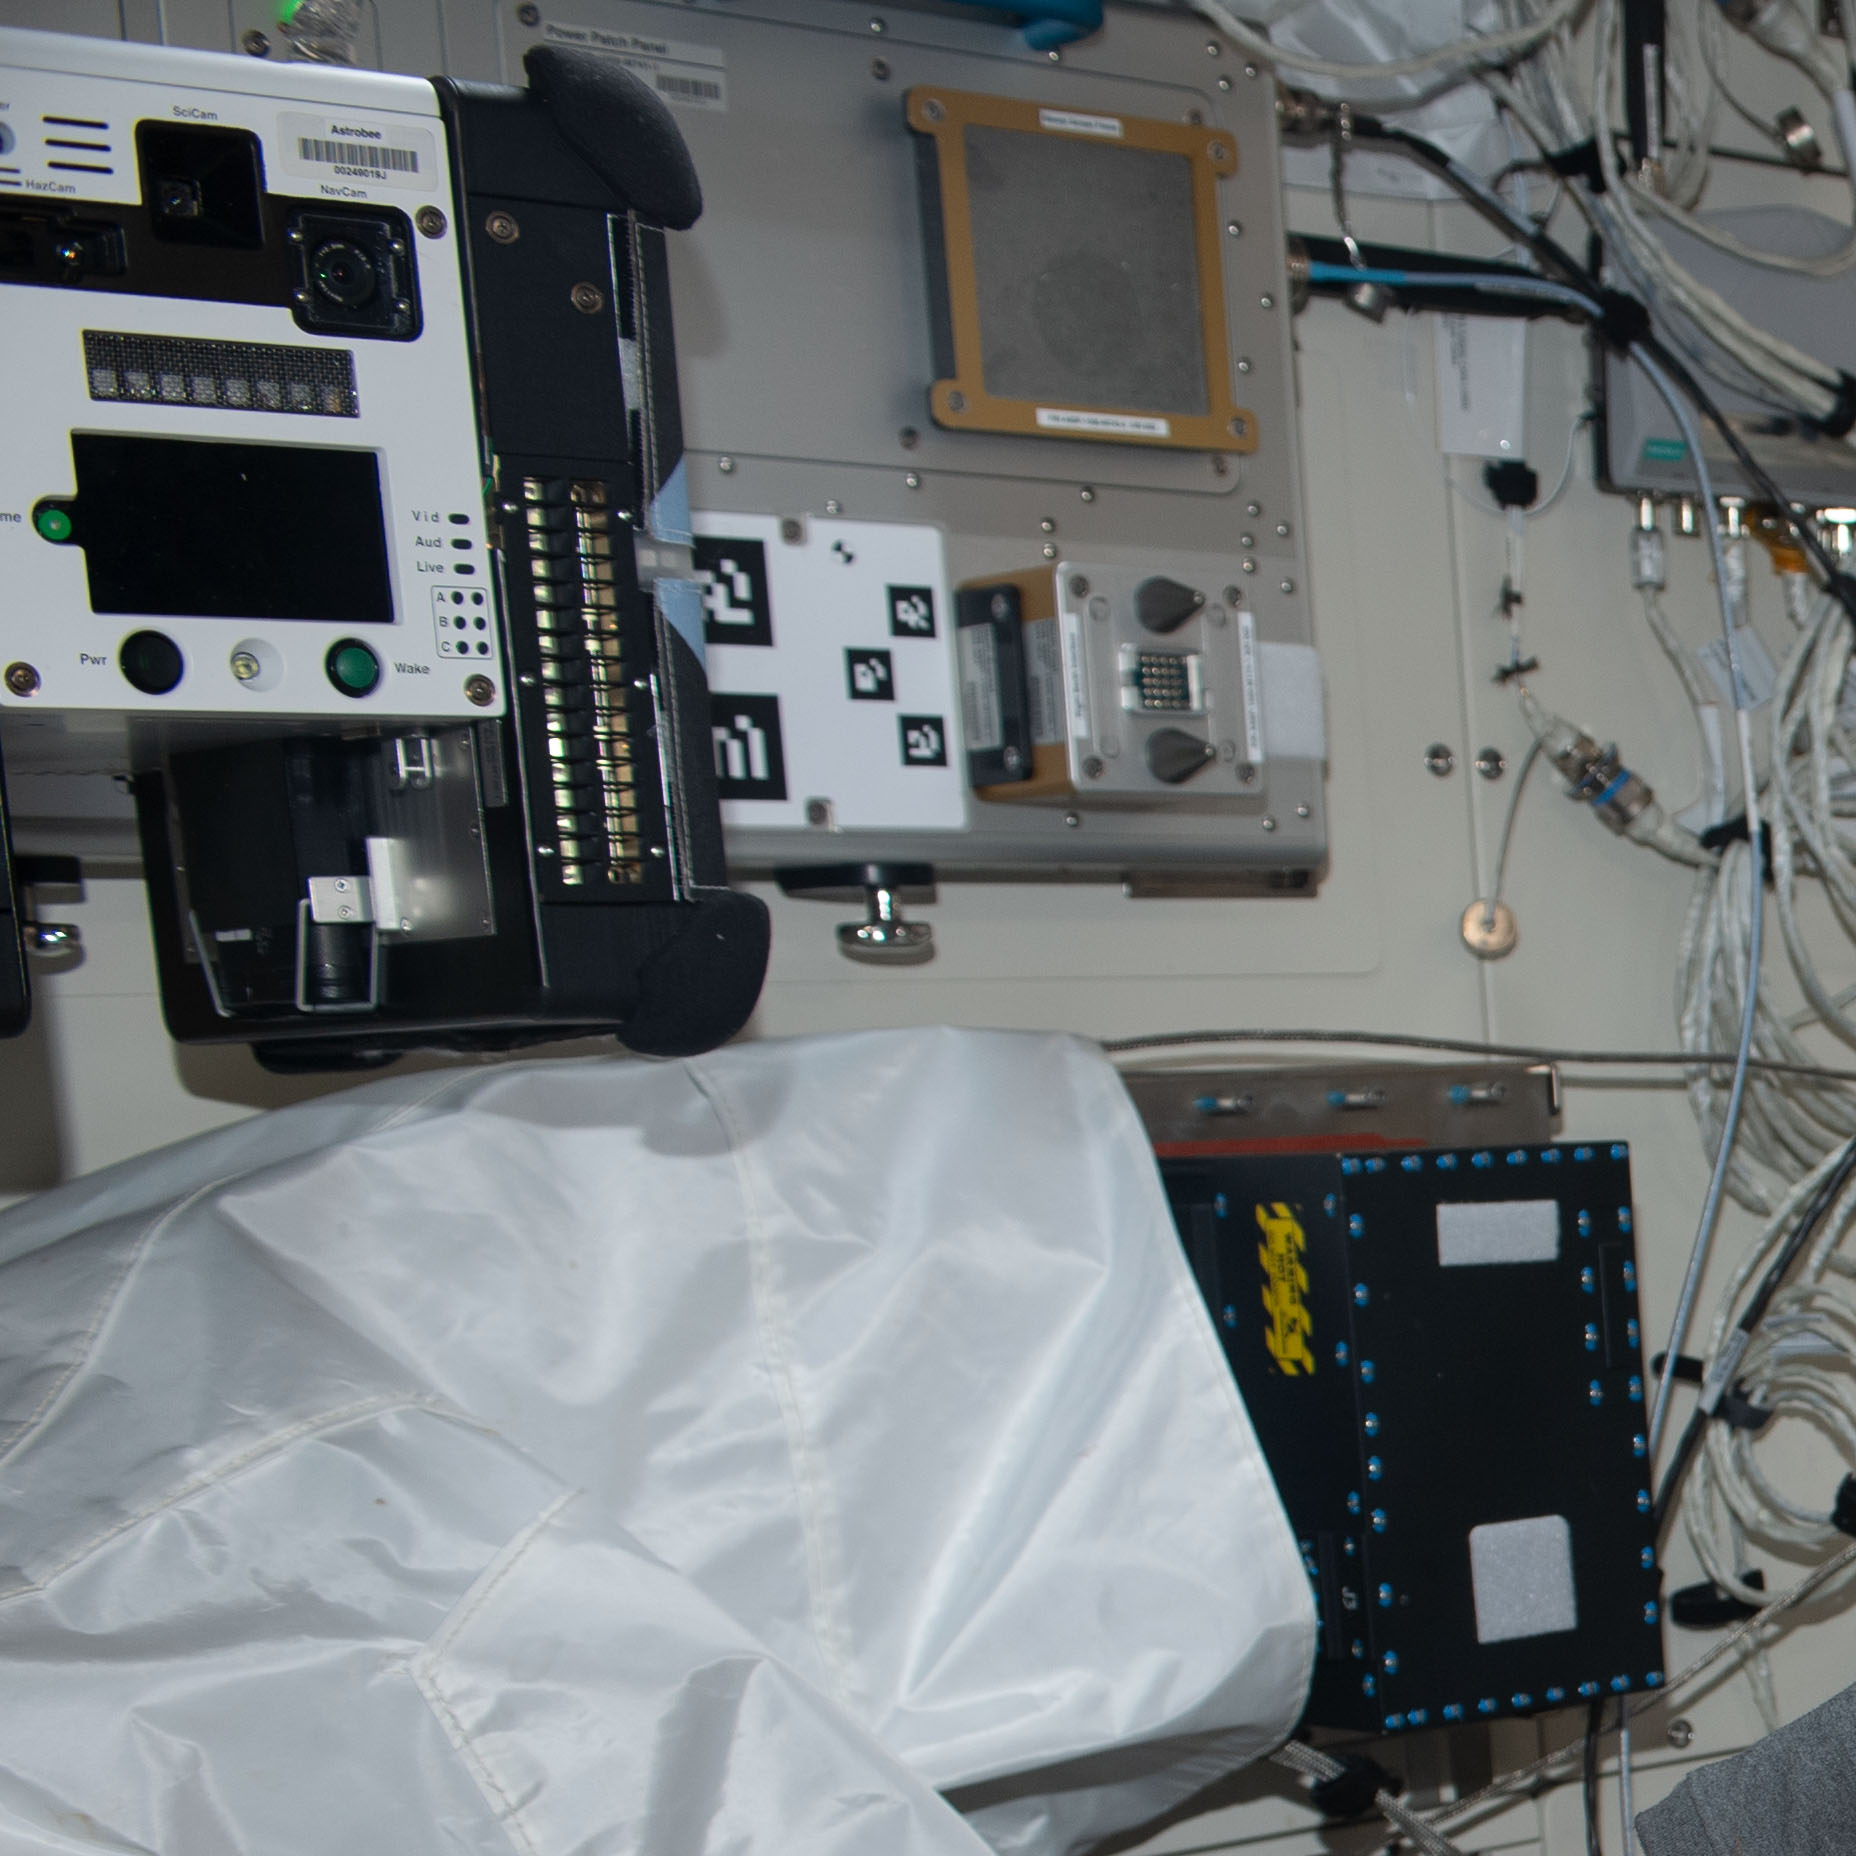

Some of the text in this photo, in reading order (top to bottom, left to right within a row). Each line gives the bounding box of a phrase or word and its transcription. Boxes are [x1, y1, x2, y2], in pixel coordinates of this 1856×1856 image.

[172, 105, 218, 121] SciCam
[331, 124, 382, 140] Astrobee
[25, 178, 76, 194] HazCam
[320, 184, 367, 199] NavCam
[412, 510, 440, 522] Vid
[415, 536, 442, 548] Aud
[416, 561, 444, 573] Live
[437, 592, 445, 602] A
[439, 617, 448, 627] B
[441, 641, 450, 652] C
[80, 653, 107, 666] Pwr
[394, 662, 430, 674] Wake
